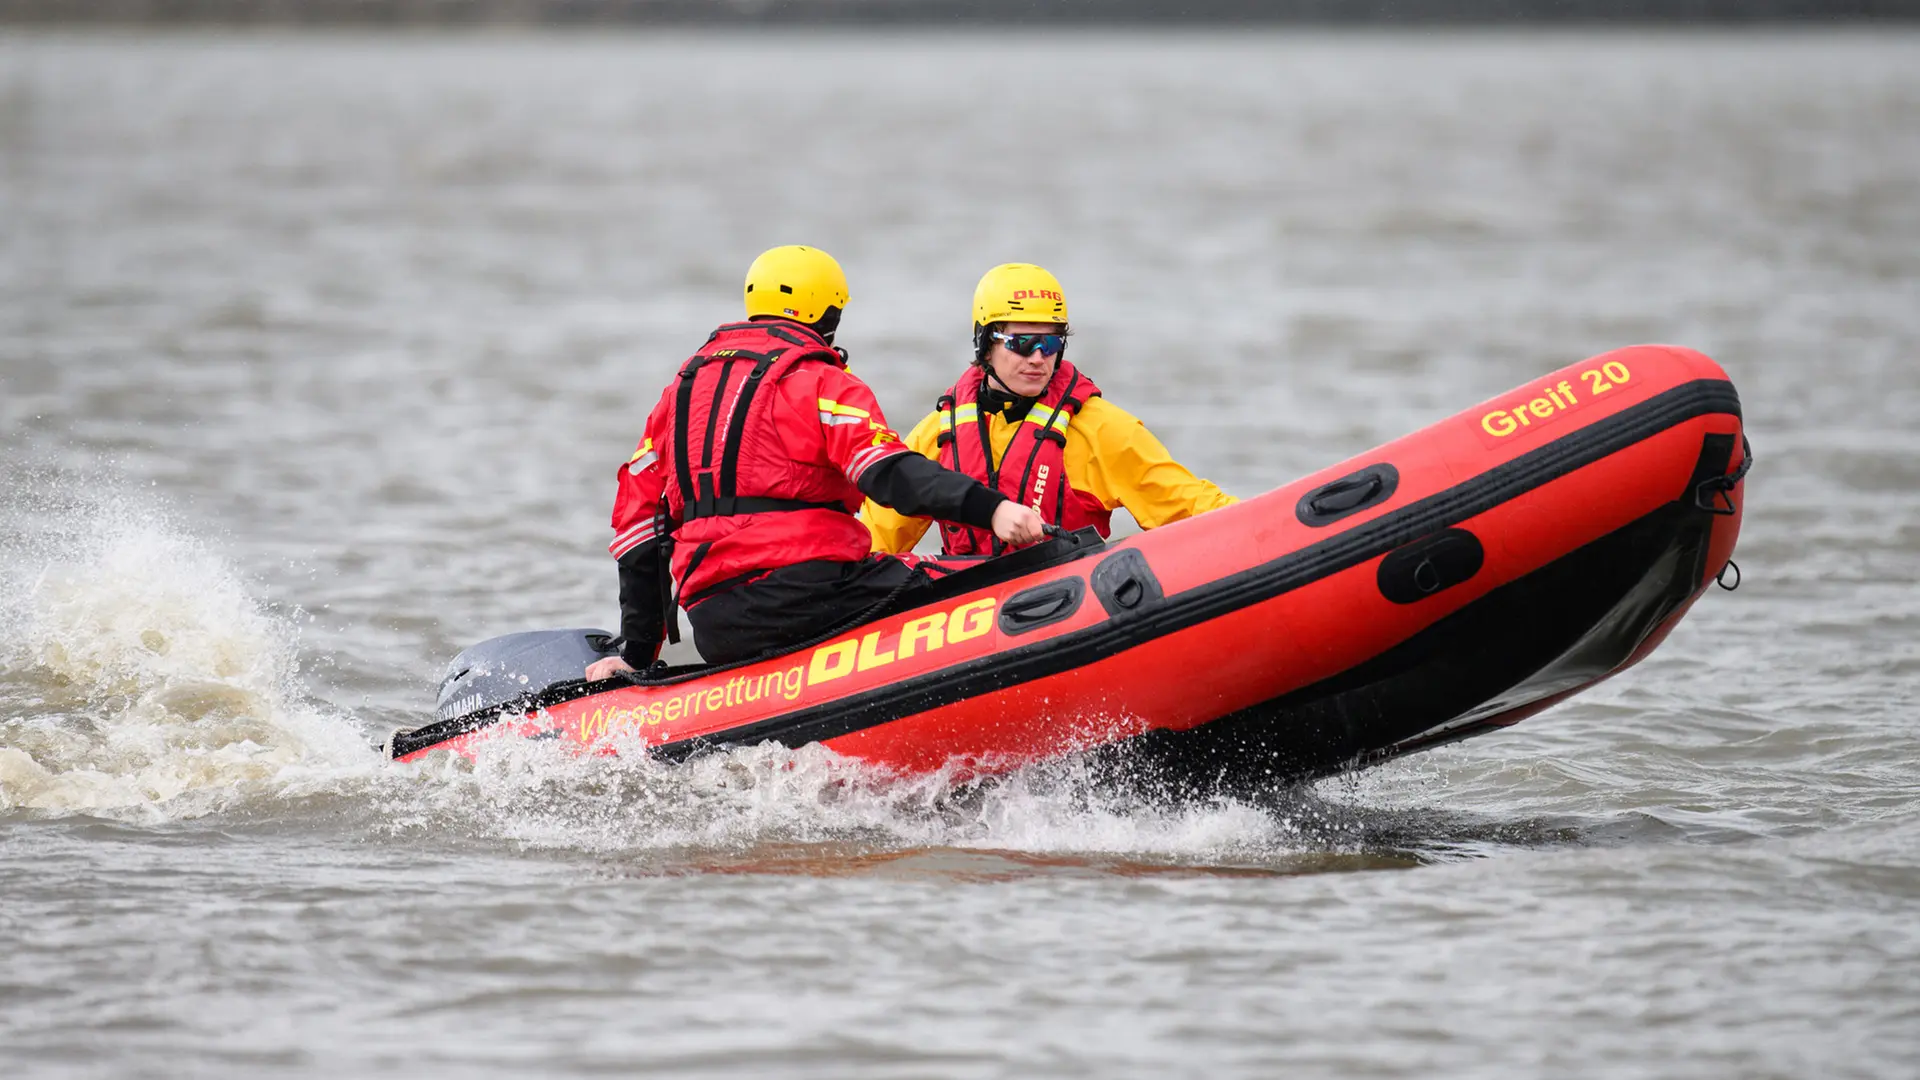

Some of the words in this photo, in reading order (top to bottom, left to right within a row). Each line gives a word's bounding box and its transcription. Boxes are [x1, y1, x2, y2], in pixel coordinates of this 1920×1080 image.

[1013, 289, 1062, 302] DLRG
[1481, 380, 1578, 437] Greif
[1580, 361, 1630, 395] 20
[807, 597, 997, 686] DLRG
[442, 692, 483, 721] YAMAHA
